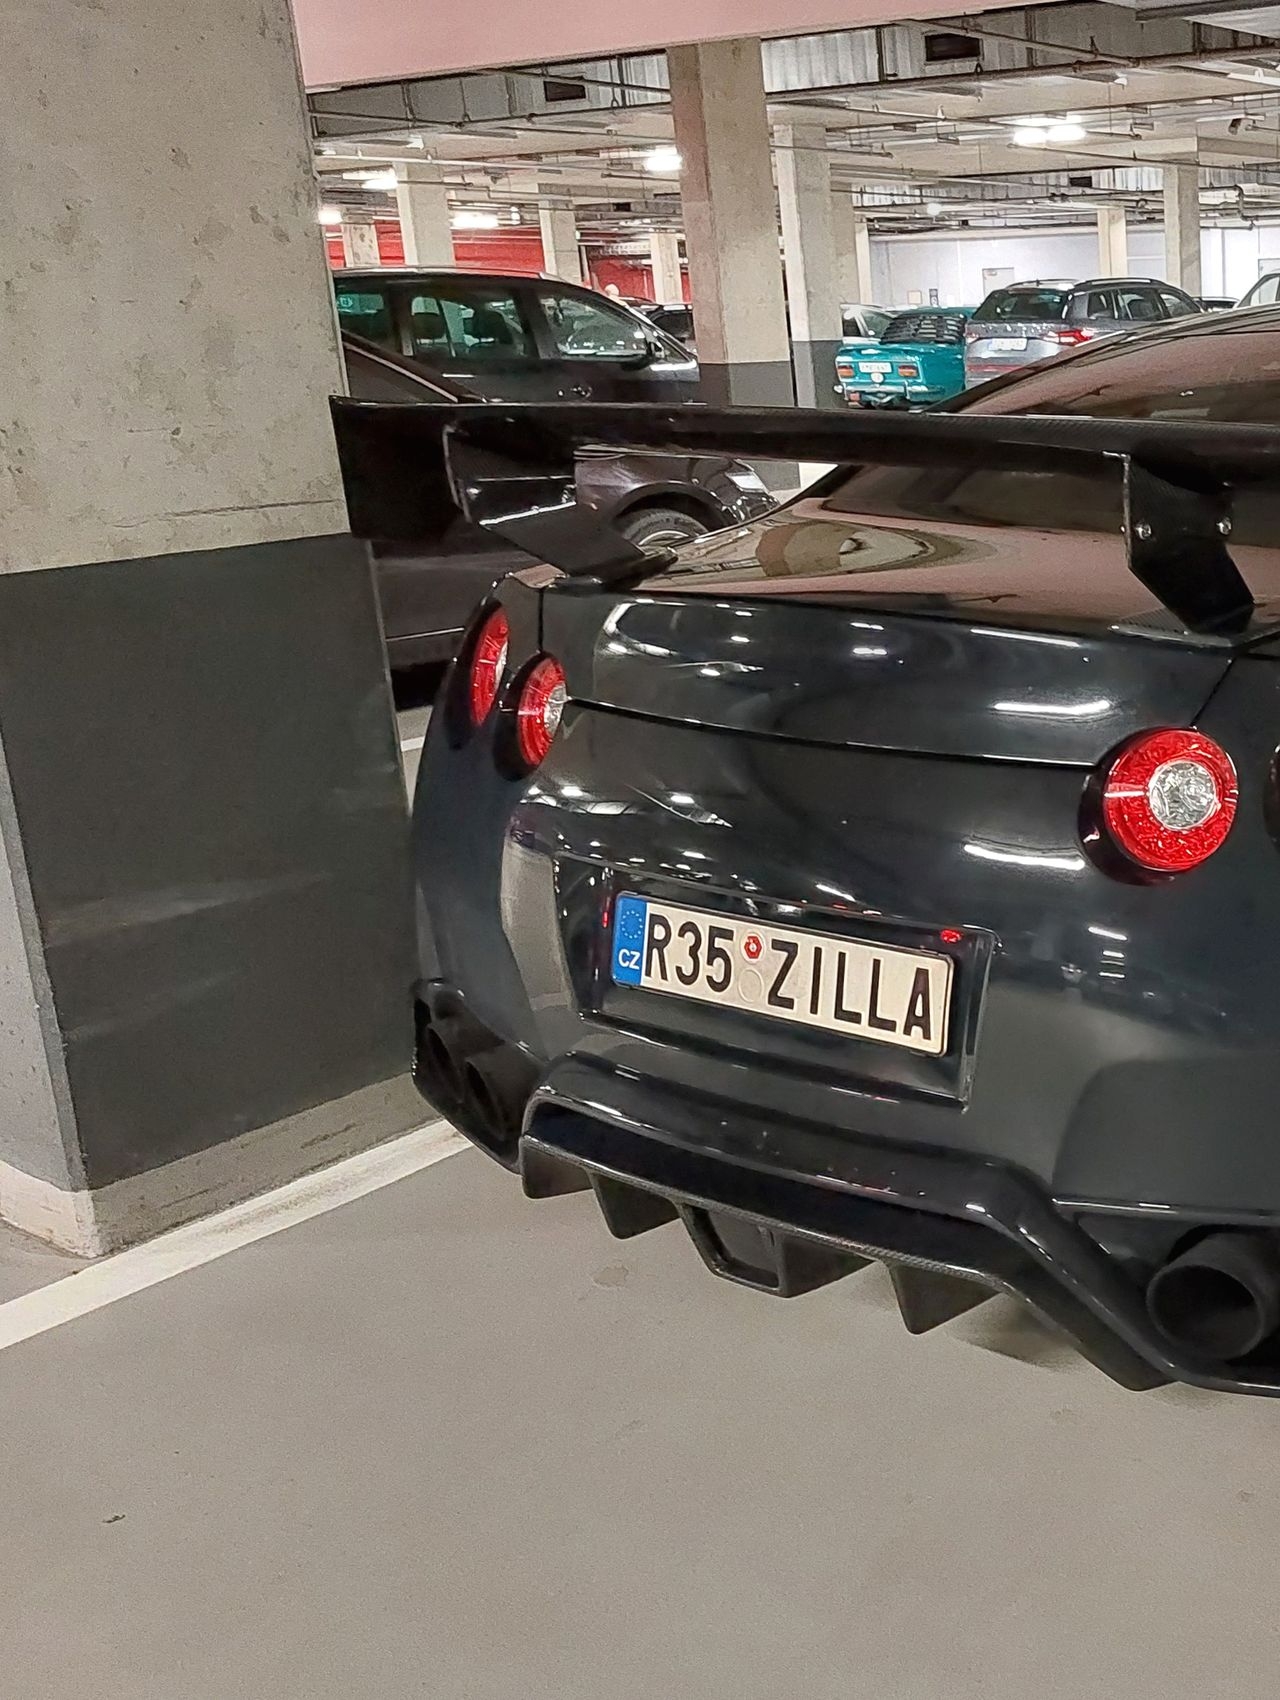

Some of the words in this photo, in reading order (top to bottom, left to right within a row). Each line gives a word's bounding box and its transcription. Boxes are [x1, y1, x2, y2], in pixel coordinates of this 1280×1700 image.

[618, 948, 641, 970] CZ
[645, 914, 734, 993] R35
[767, 939, 932, 1041] ZILLA
